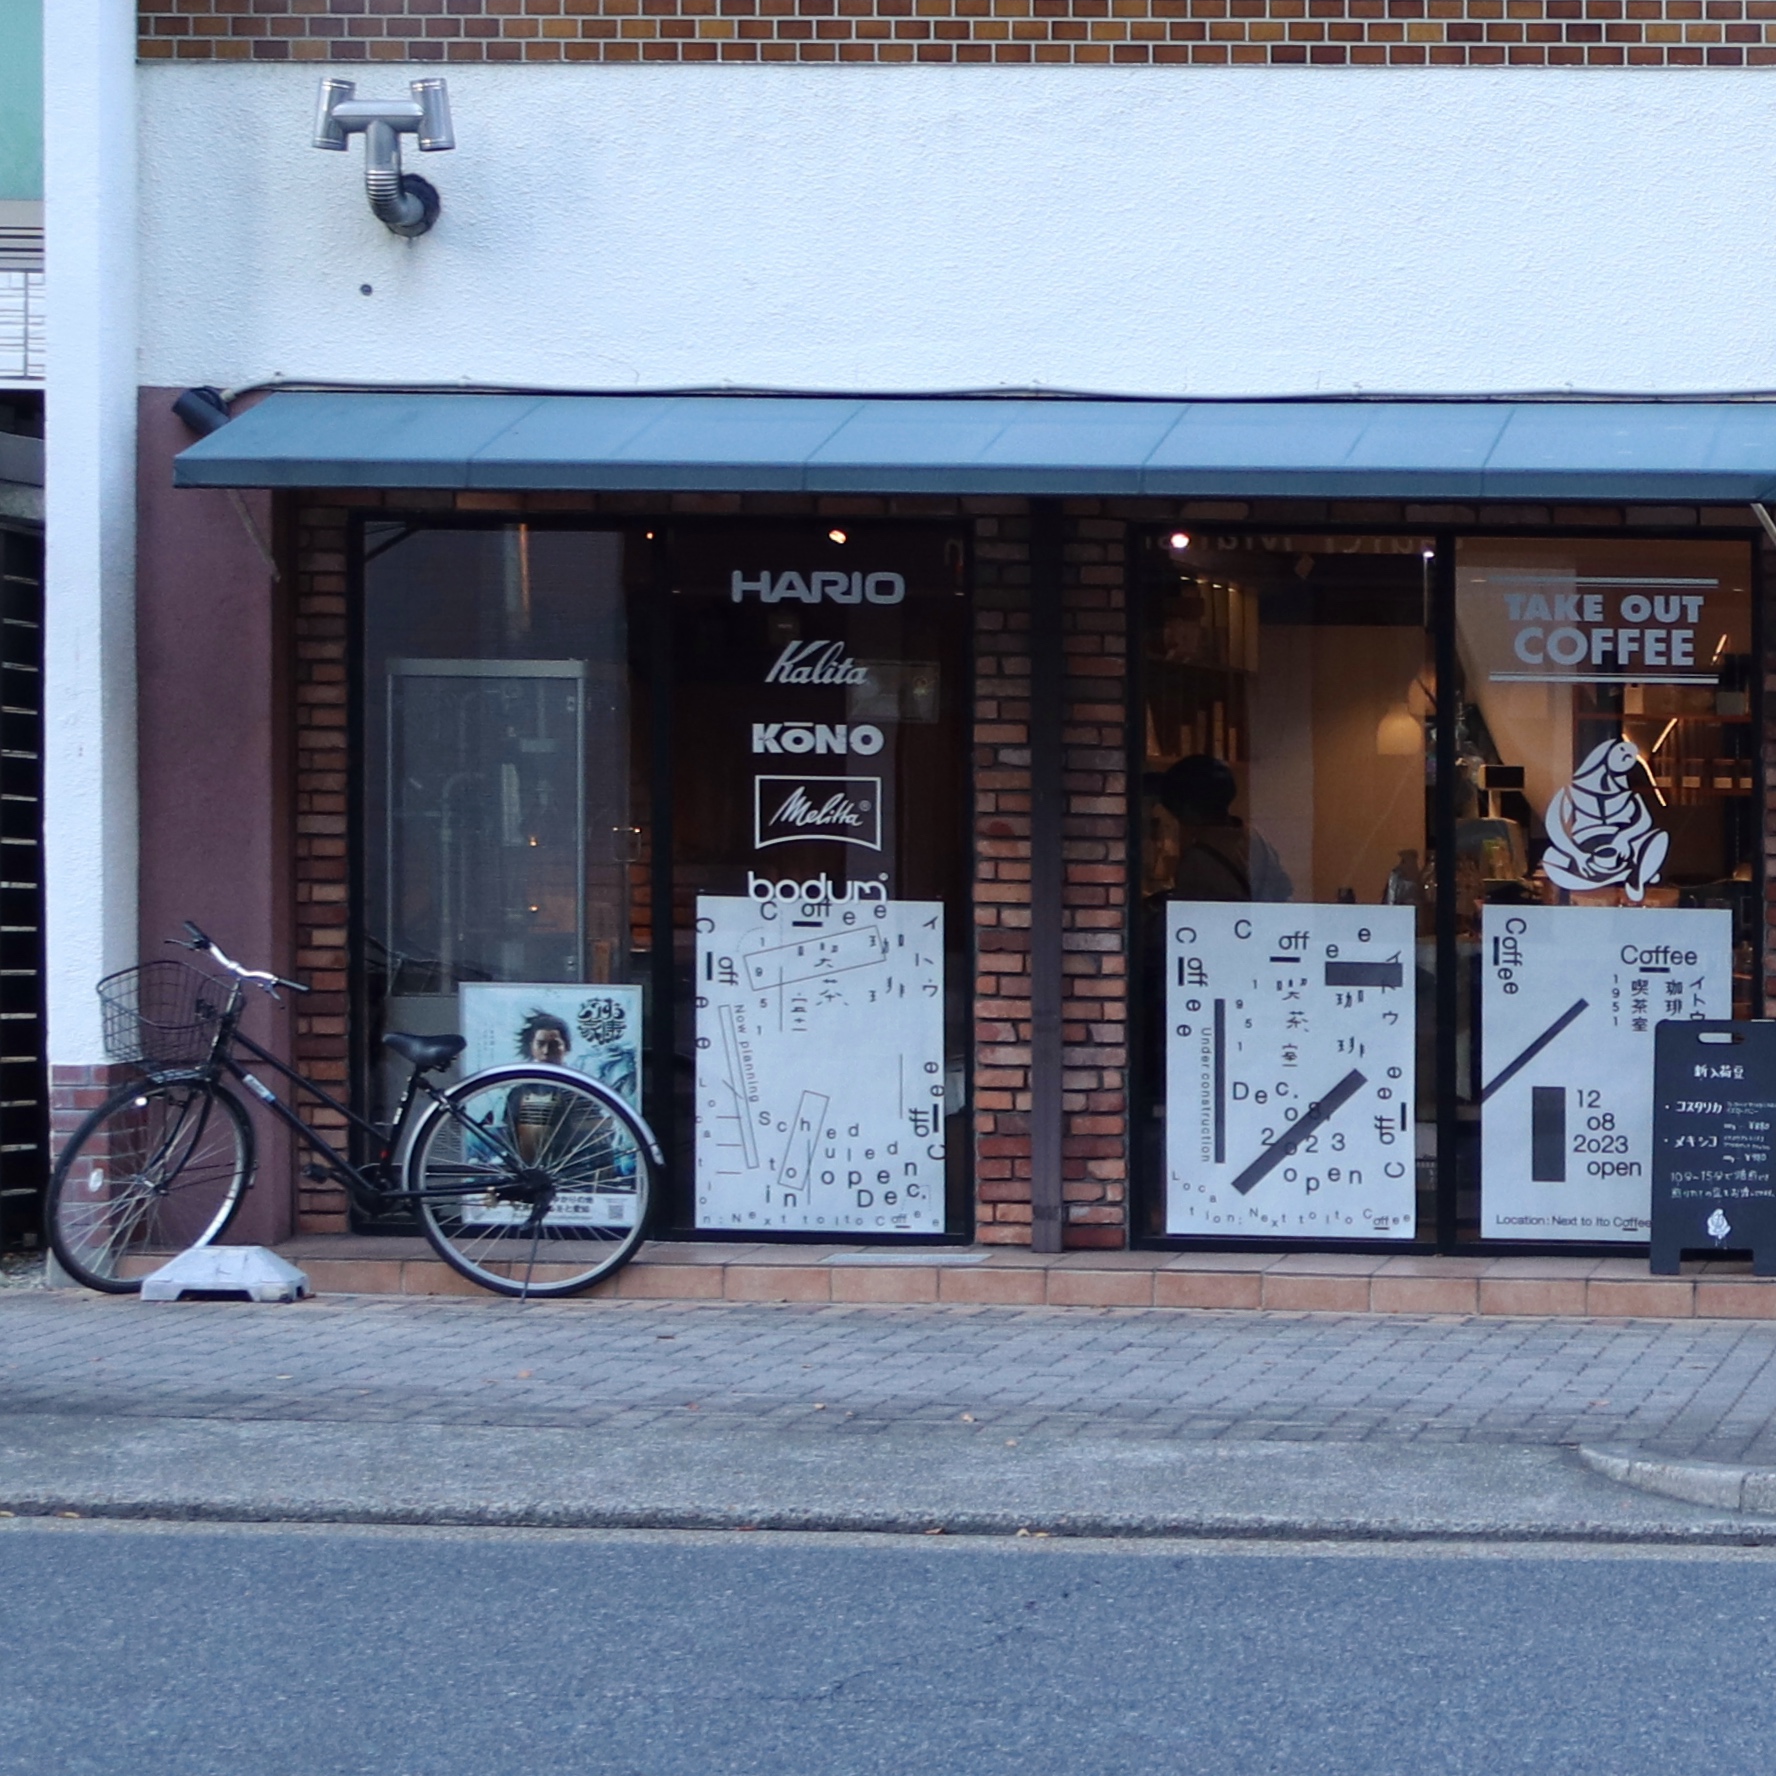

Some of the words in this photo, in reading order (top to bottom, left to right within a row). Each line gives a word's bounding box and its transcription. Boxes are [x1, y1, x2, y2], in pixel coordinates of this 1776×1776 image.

[731, 570, 906, 604] HARIO
[1503, 594, 1604, 622] TAKE
[1620, 594, 1704, 623] OUT
[764, 640, 869, 685] Kalita
[1514, 626, 1694, 666] COFFEE
[768, 786, 863, 826] Melitta
[747, 870, 887, 905] bodum
[1497, 917, 1527, 995] Coffee
[1620, 944, 1698, 966] Coffee
[1611, 974, 1620, 1027] 1951
[1631, 979, 1649, 1032] 喫茶室
[1201, 1027, 1212, 1068] Under
[1577, 1090, 1601, 1108] 12
[1200, 1073, 1211, 1163] construction
[1284, 1167, 1363, 1195] open
[1586, 1159, 1642, 1178] open
[1496, 1215, 1549, 1227] Location:
[1552, 1215, 1578, 1227] Next
[1580, 1216, 1593, 1227] to
[1596, 1216, 1611, 1227] Ito
